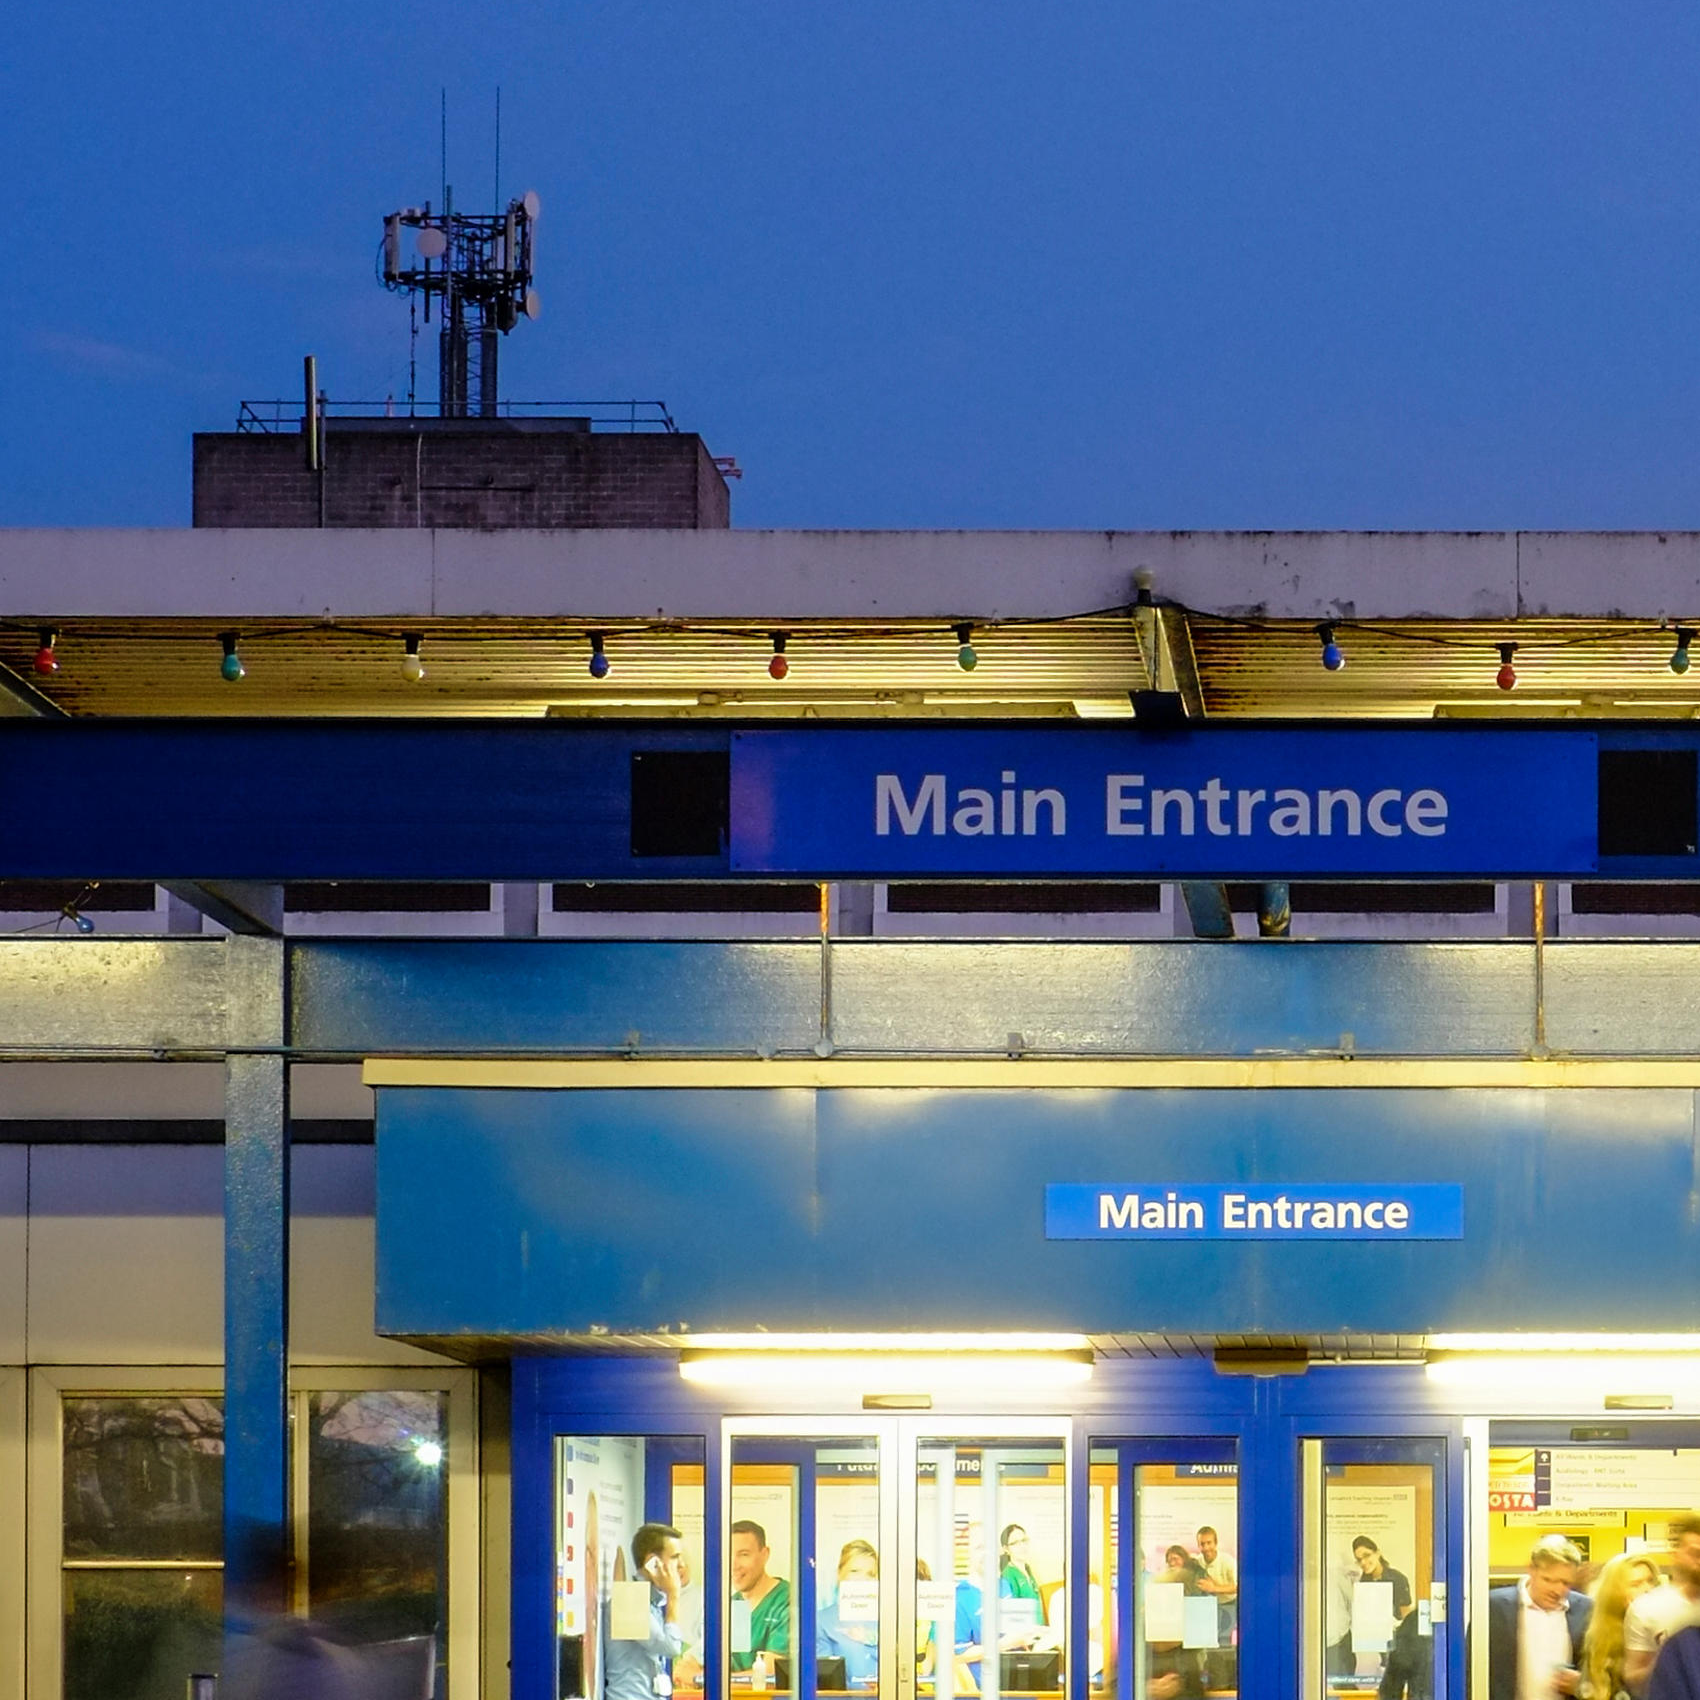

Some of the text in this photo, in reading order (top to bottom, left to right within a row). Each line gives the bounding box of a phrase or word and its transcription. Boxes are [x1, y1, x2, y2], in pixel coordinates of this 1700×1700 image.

[875, 770, 1449, 838] Main Entrance
[1098, 1192, 1409, 1231] Main Entrance
[1489, 1493, 1534, 1509] OSTA
